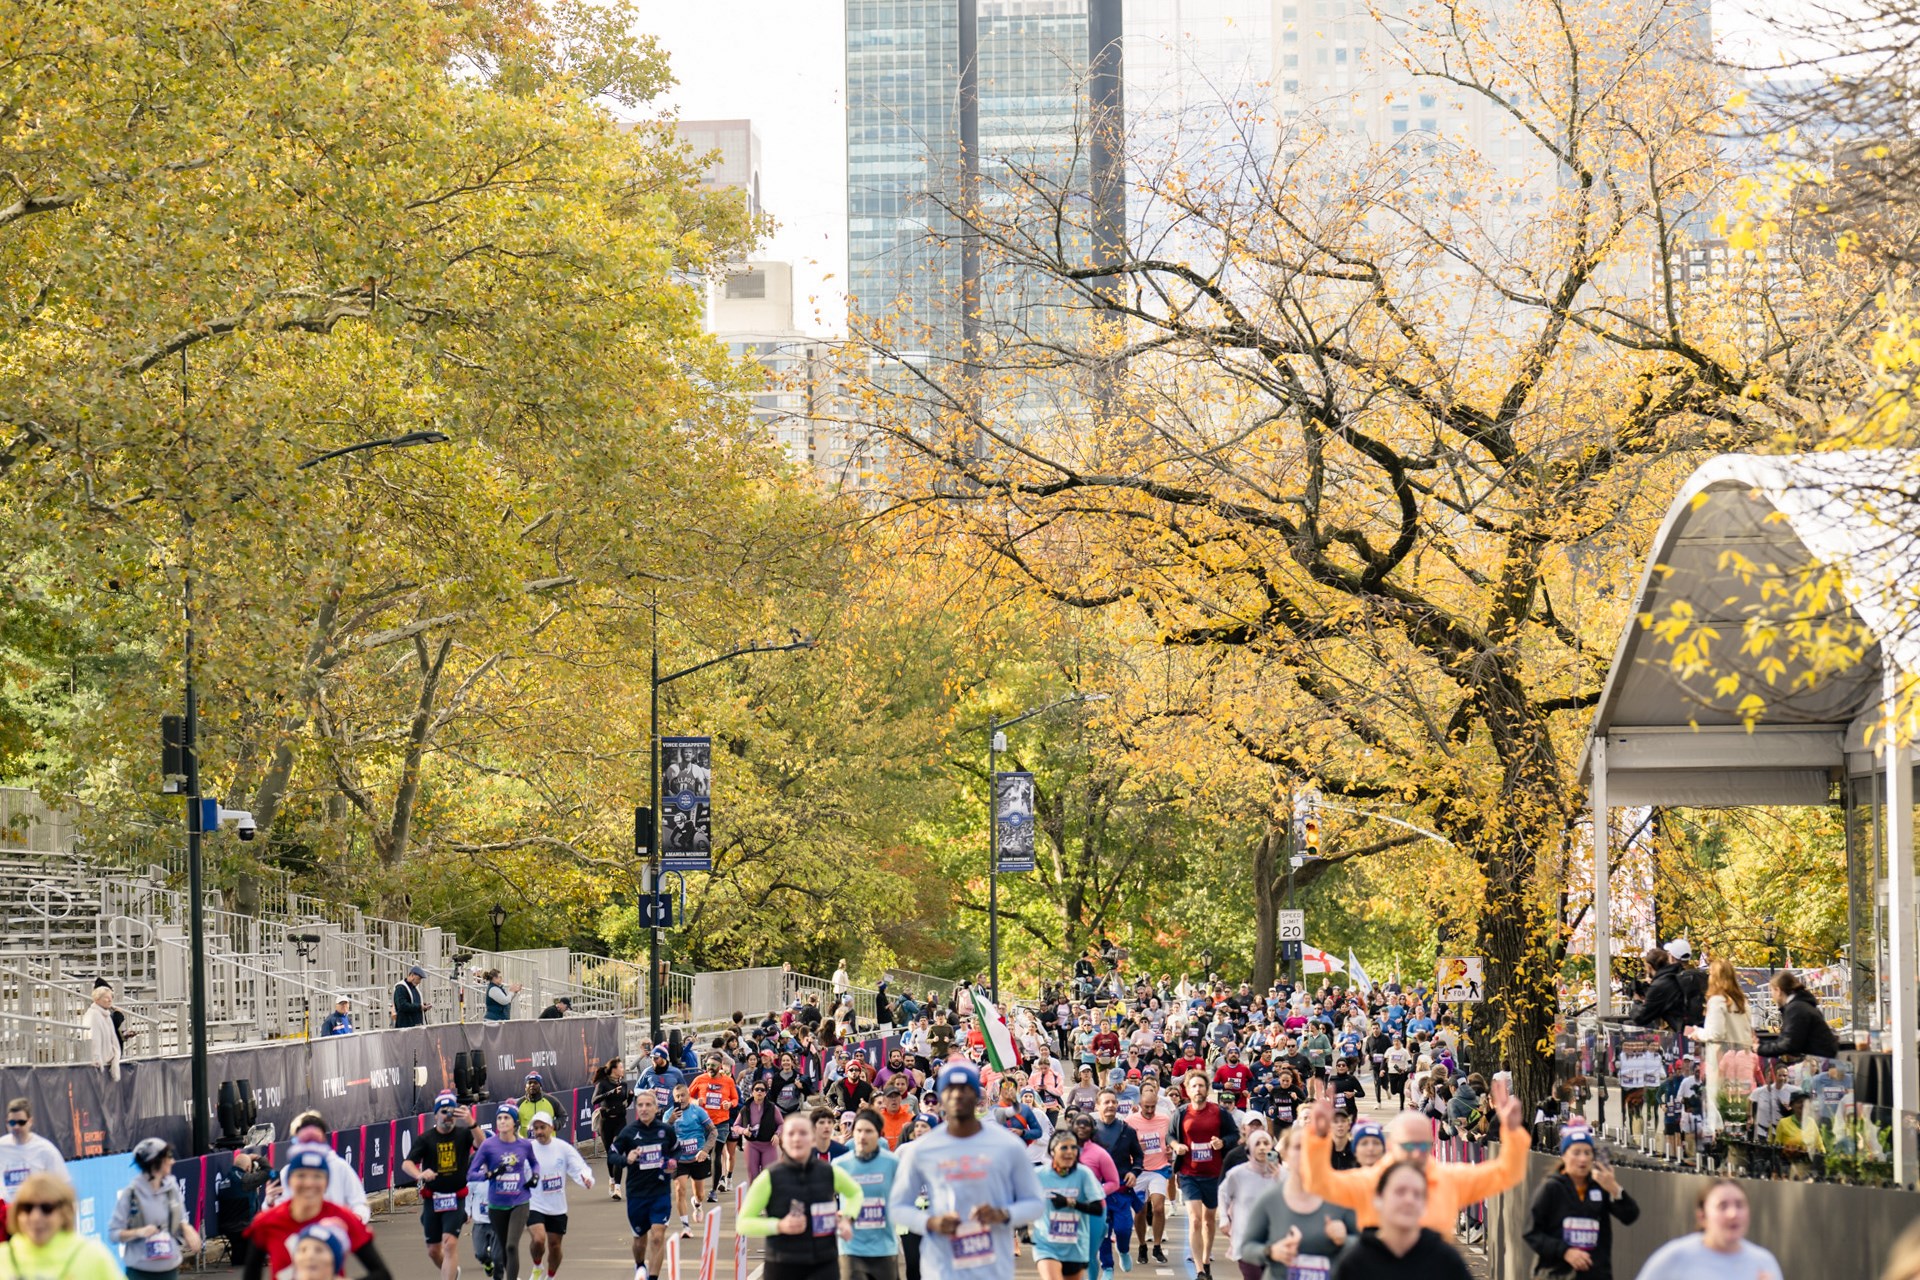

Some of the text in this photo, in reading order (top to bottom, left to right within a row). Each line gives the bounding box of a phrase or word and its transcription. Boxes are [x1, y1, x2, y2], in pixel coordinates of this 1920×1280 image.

[1282, 926, 1301, 937] 20
[497, 1050, 557, 1071] IT WILL MOVE YOU
[322, 1079, 330, 1099] IT
[330, 1076, 347, 1098] WILL
[370, 1068, 389, 1089] MOVE
[265, 1086, 281, 1109] YOU
[503, 1181, 518, 1191] 9277
